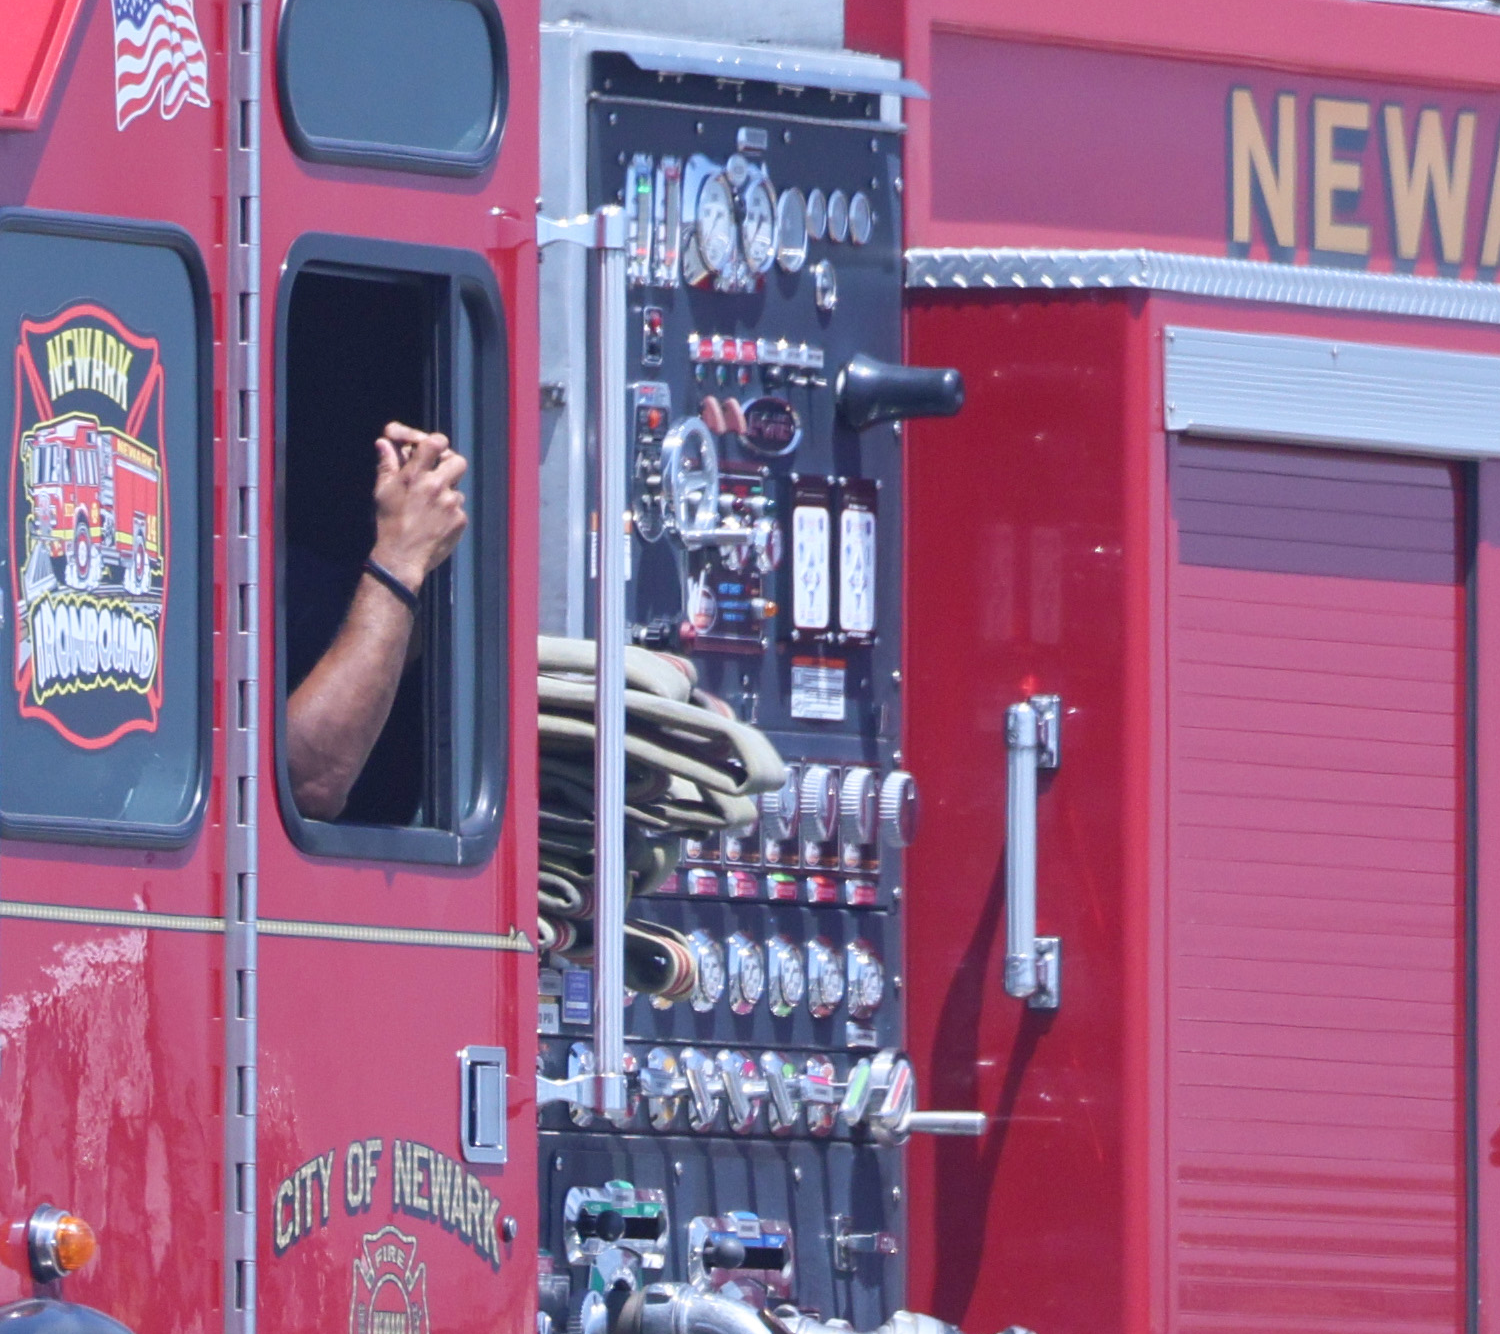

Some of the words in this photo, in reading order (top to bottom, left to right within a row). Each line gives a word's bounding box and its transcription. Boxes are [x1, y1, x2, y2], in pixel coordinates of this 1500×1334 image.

[46, 327, 134, 413] NEWARK
[34, 598, 155, 689] IRONBOUND
[273, 1147, 336, 1255] CITY
[344, 1138, 384, 1214] OF
[392, 1138, 501, 1271] NEWARK
[374, 1244, 407, 1270] FIRE
